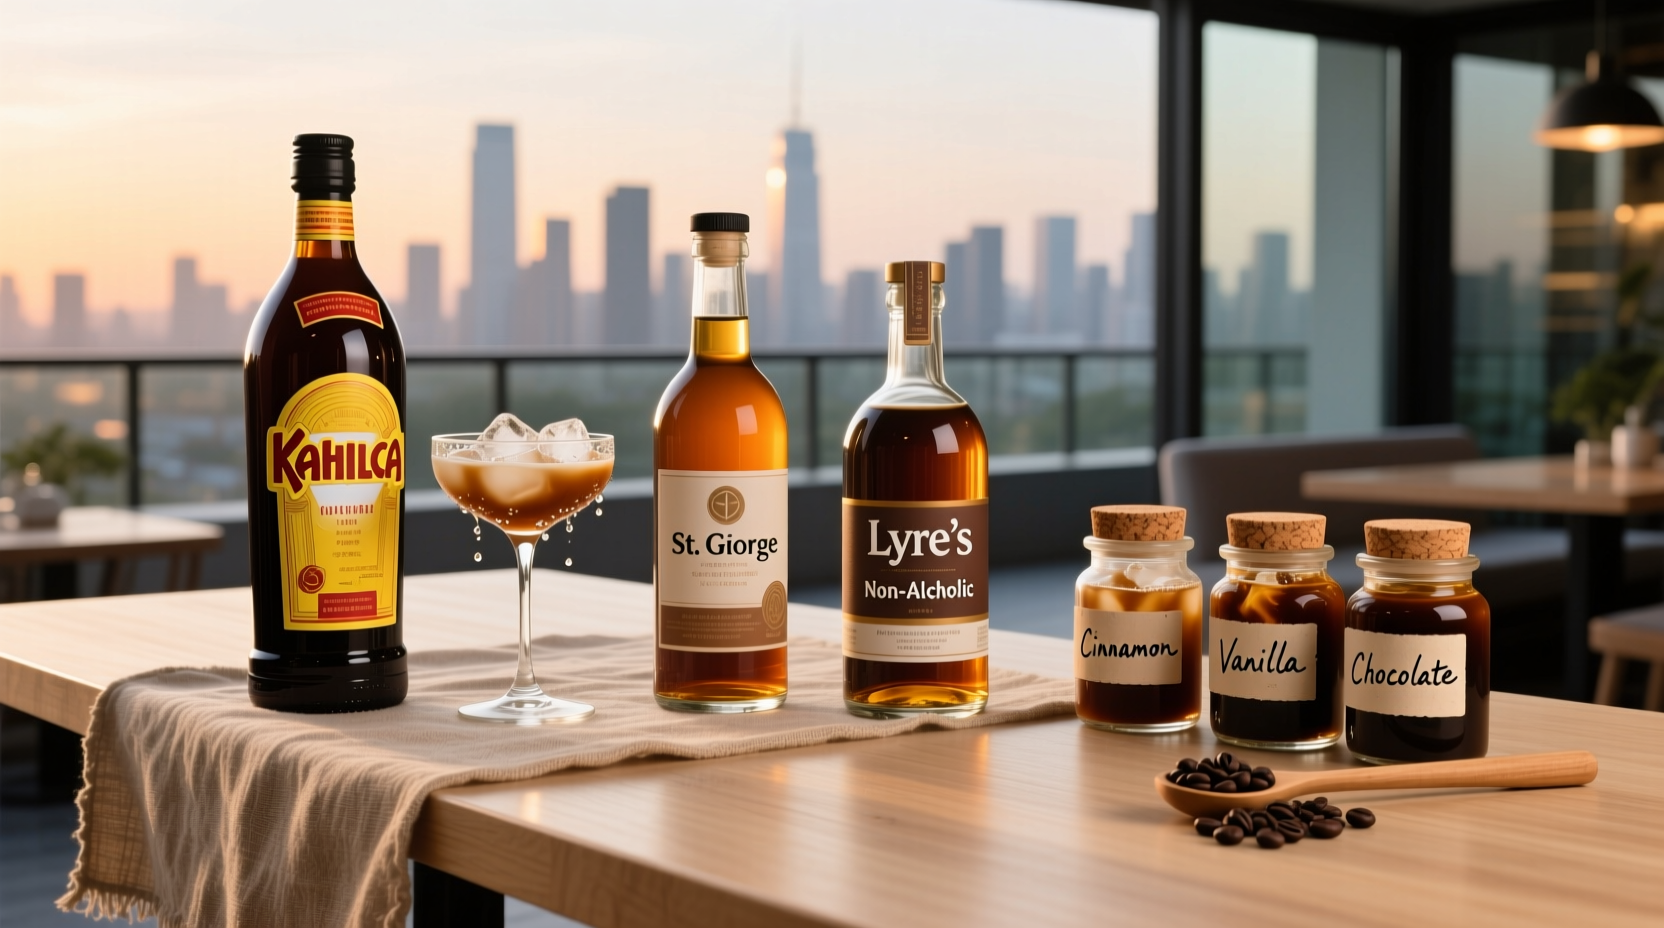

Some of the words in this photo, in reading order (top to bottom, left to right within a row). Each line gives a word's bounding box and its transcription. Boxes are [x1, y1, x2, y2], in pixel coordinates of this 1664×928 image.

[273, 428, 402, 494] KAHILCA
[672, 531, 700, 556] St.
[706, 532, 778, 562] Giorge
[864, 578, 974, 600] Non-Alcholic
[1080, 627, 1179, 658] Cinnamon
[1219, 637, 1307, 675] Vanilla
[1351, 651, 1459, 687] Chocolate
